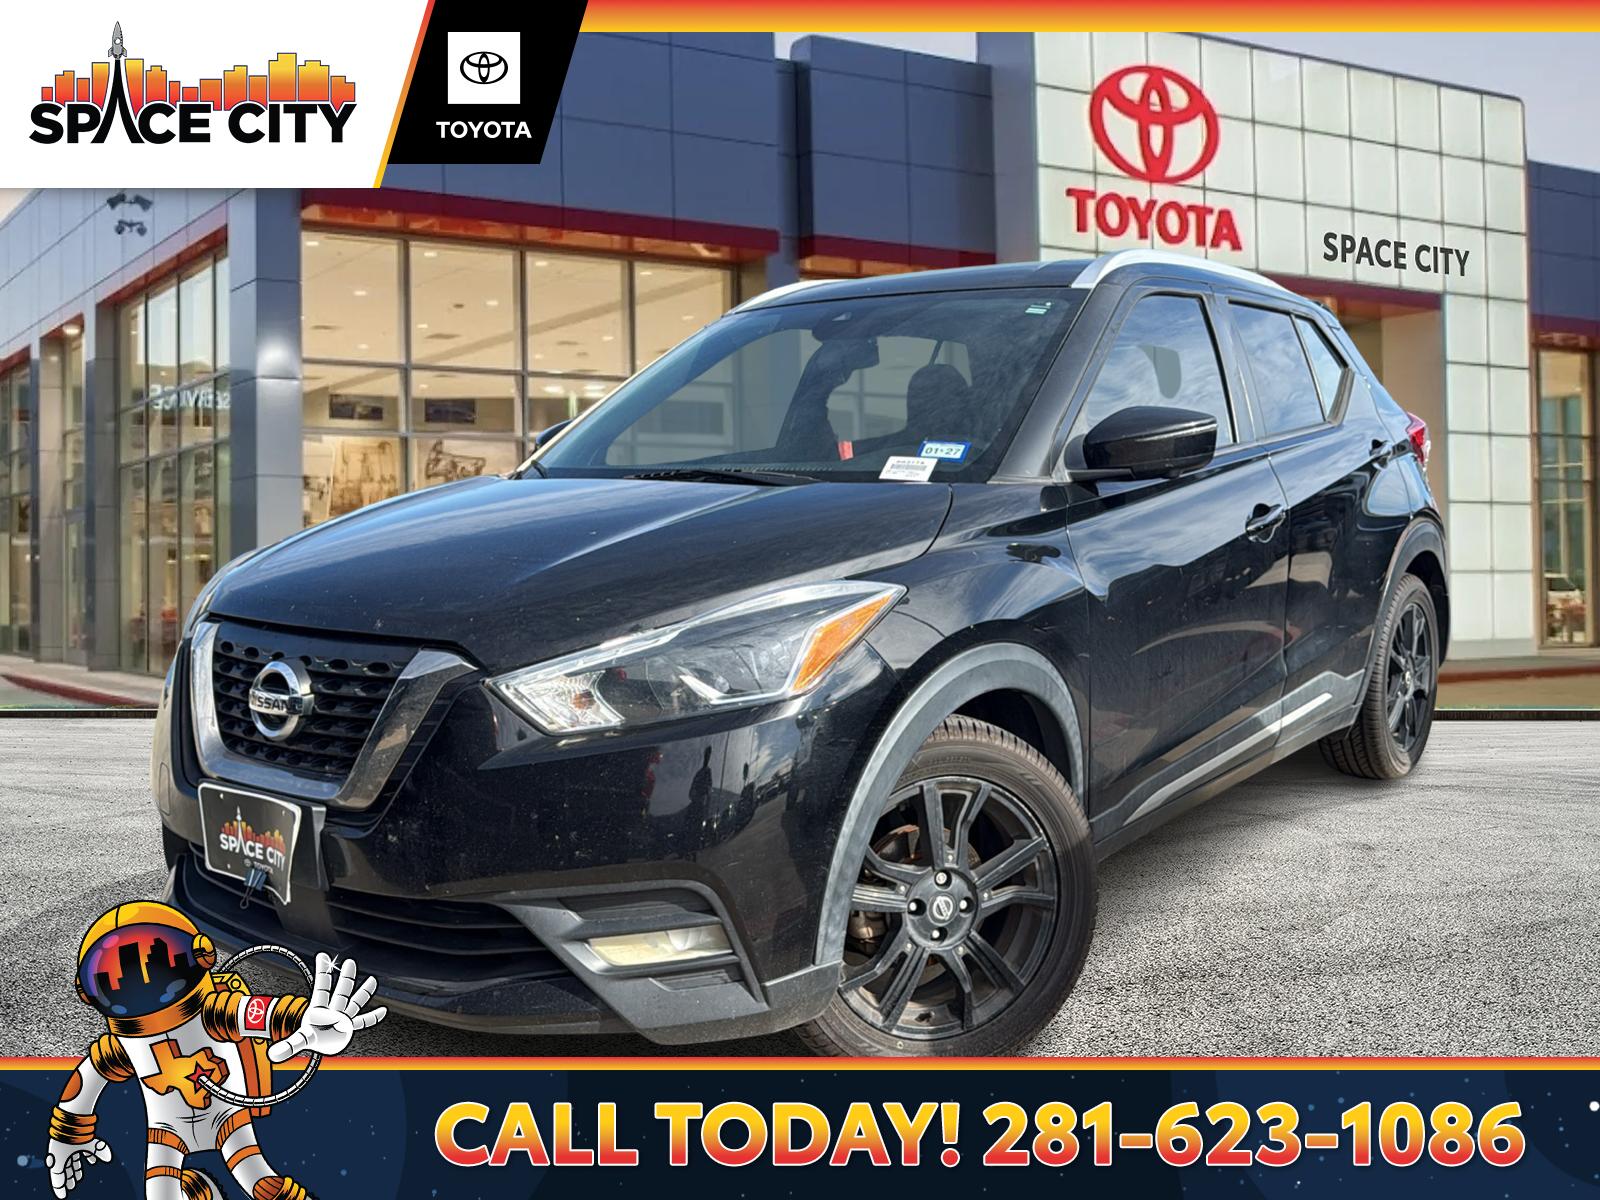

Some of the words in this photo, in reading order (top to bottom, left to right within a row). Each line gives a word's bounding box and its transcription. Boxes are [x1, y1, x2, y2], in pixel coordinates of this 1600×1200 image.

[1066, 187, 1243, 252] TOYOTA
[1323, 232, 1407, 270] SPACE
[1414, 243, 1470, 277] CITY
[219, 820, 264, 860] SPACE
[266, 846, 286, 871] CITY
